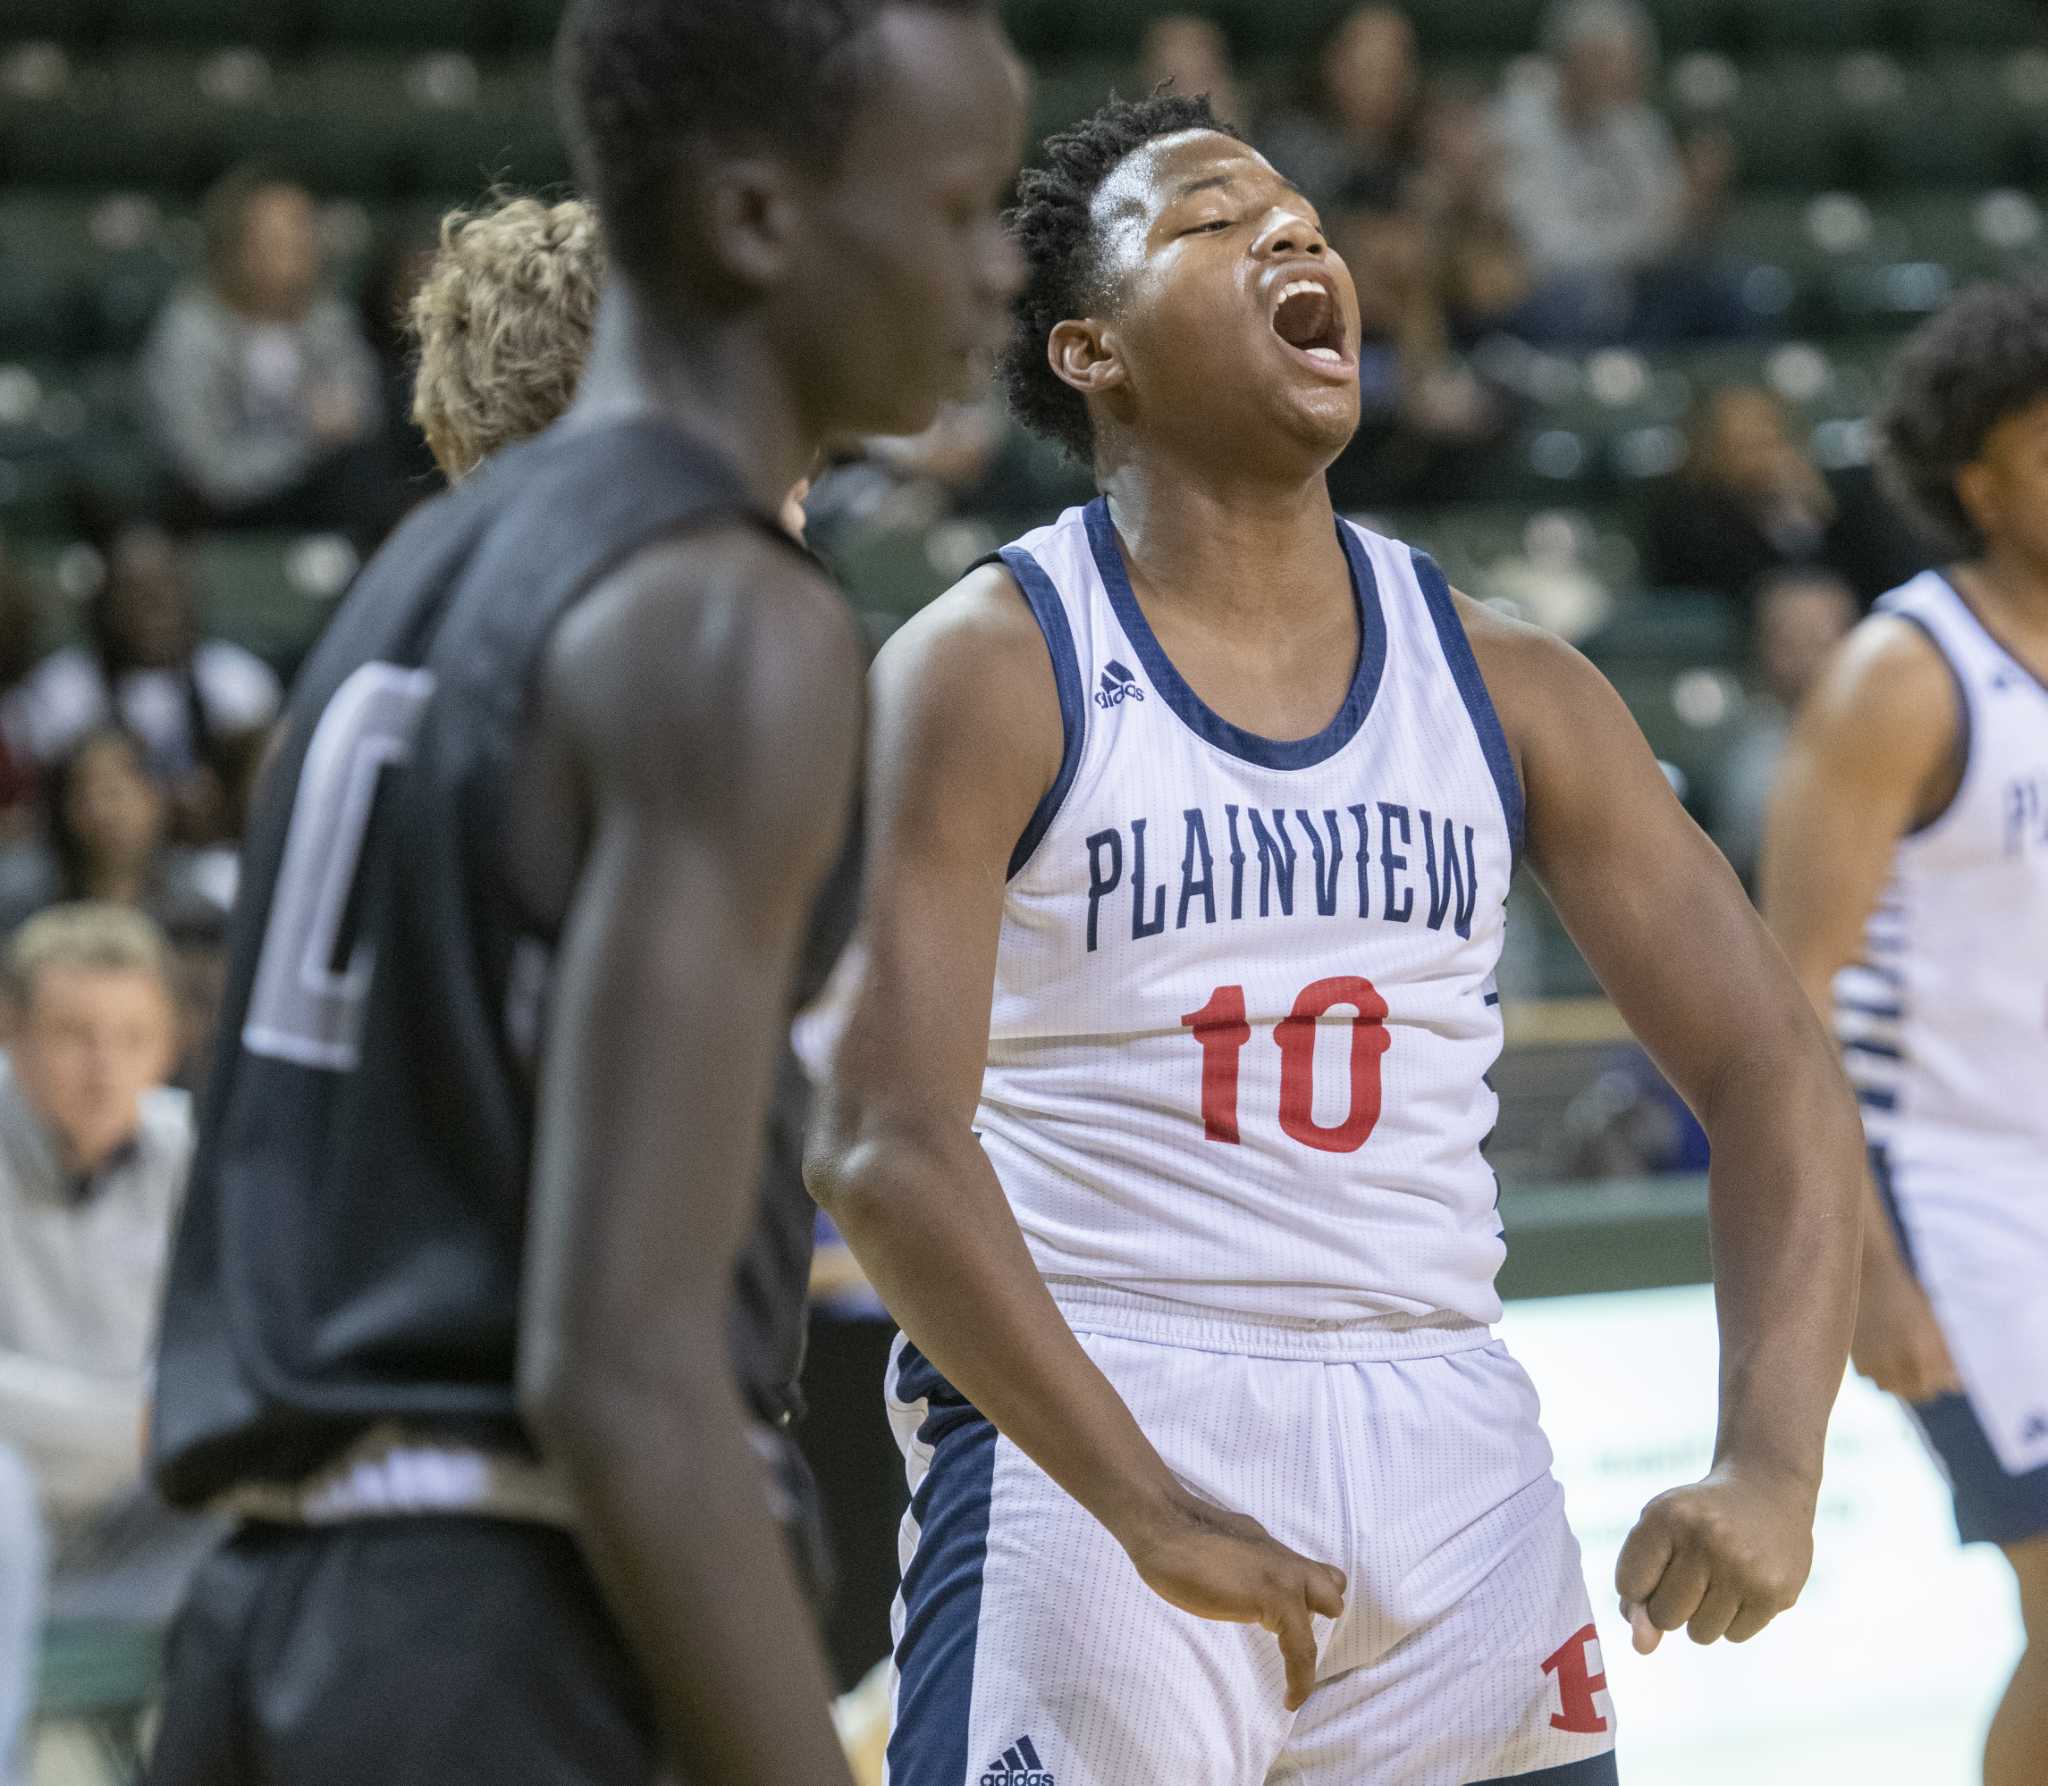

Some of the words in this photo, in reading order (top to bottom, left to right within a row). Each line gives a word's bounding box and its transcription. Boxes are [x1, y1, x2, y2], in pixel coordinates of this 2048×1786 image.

[1094, 684, 1144, 709] adidas
[1086, 801, 1478, 952] PLAINVIEW
[1181, 975, 1391, 1153] 10
[980, 1769, 1055, 1786] adidas
